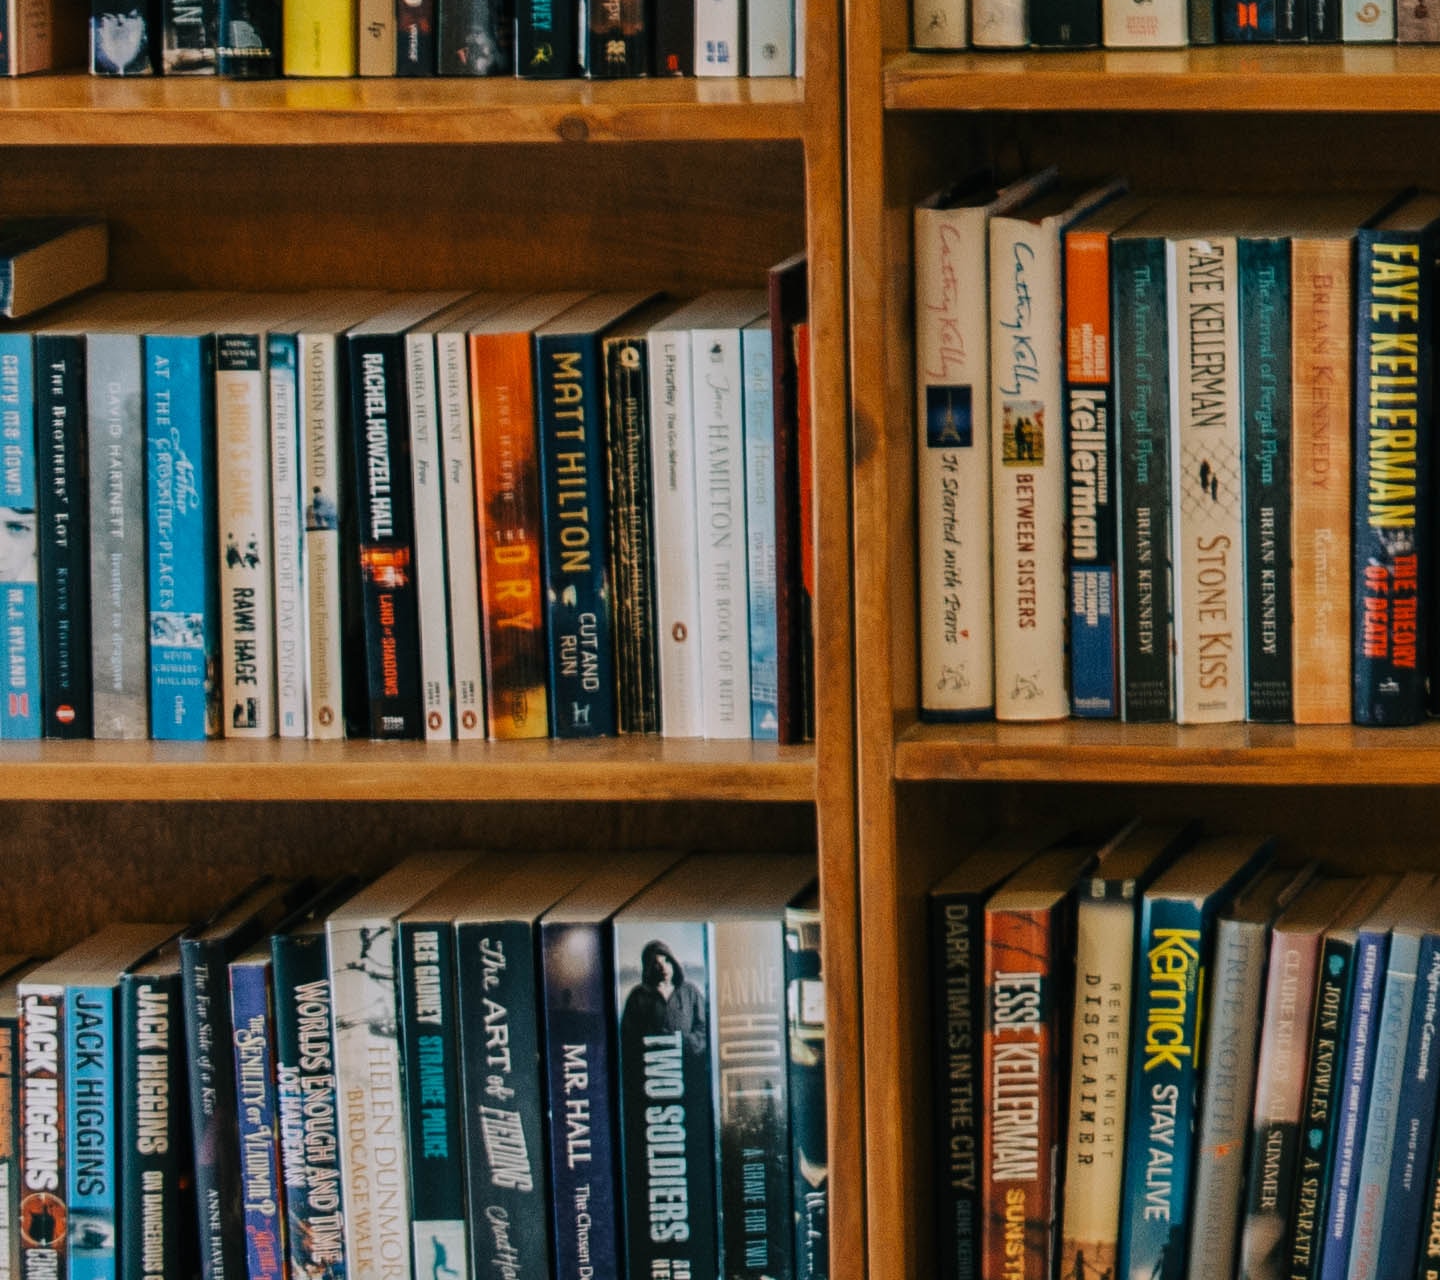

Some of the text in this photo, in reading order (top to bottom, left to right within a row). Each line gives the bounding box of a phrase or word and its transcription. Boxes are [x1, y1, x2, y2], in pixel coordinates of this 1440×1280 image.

[552, 352, 591, 573] MATT HILTON
[1367, 243, 1421, 529] FAYE KELLERMAN
[1070, 390, 1105, 559] kellerman
[1197, 534, 1233, 689] STONE KISS
[135, 985, 168, 1154] JACK HIGGINS
[992, 971, 1041, 1182] JESSE KELLERMAN
[1076, 974, 1099, 1167] DISCLAIMER
[1142, 929, 1200, 1071] Kernick
[74, 994, 104, 1196] JACK HIGGINS
[566, 1099, 590, 1168] HALL
[1144, 1083, 1179, 1222] STAY ALIVE
